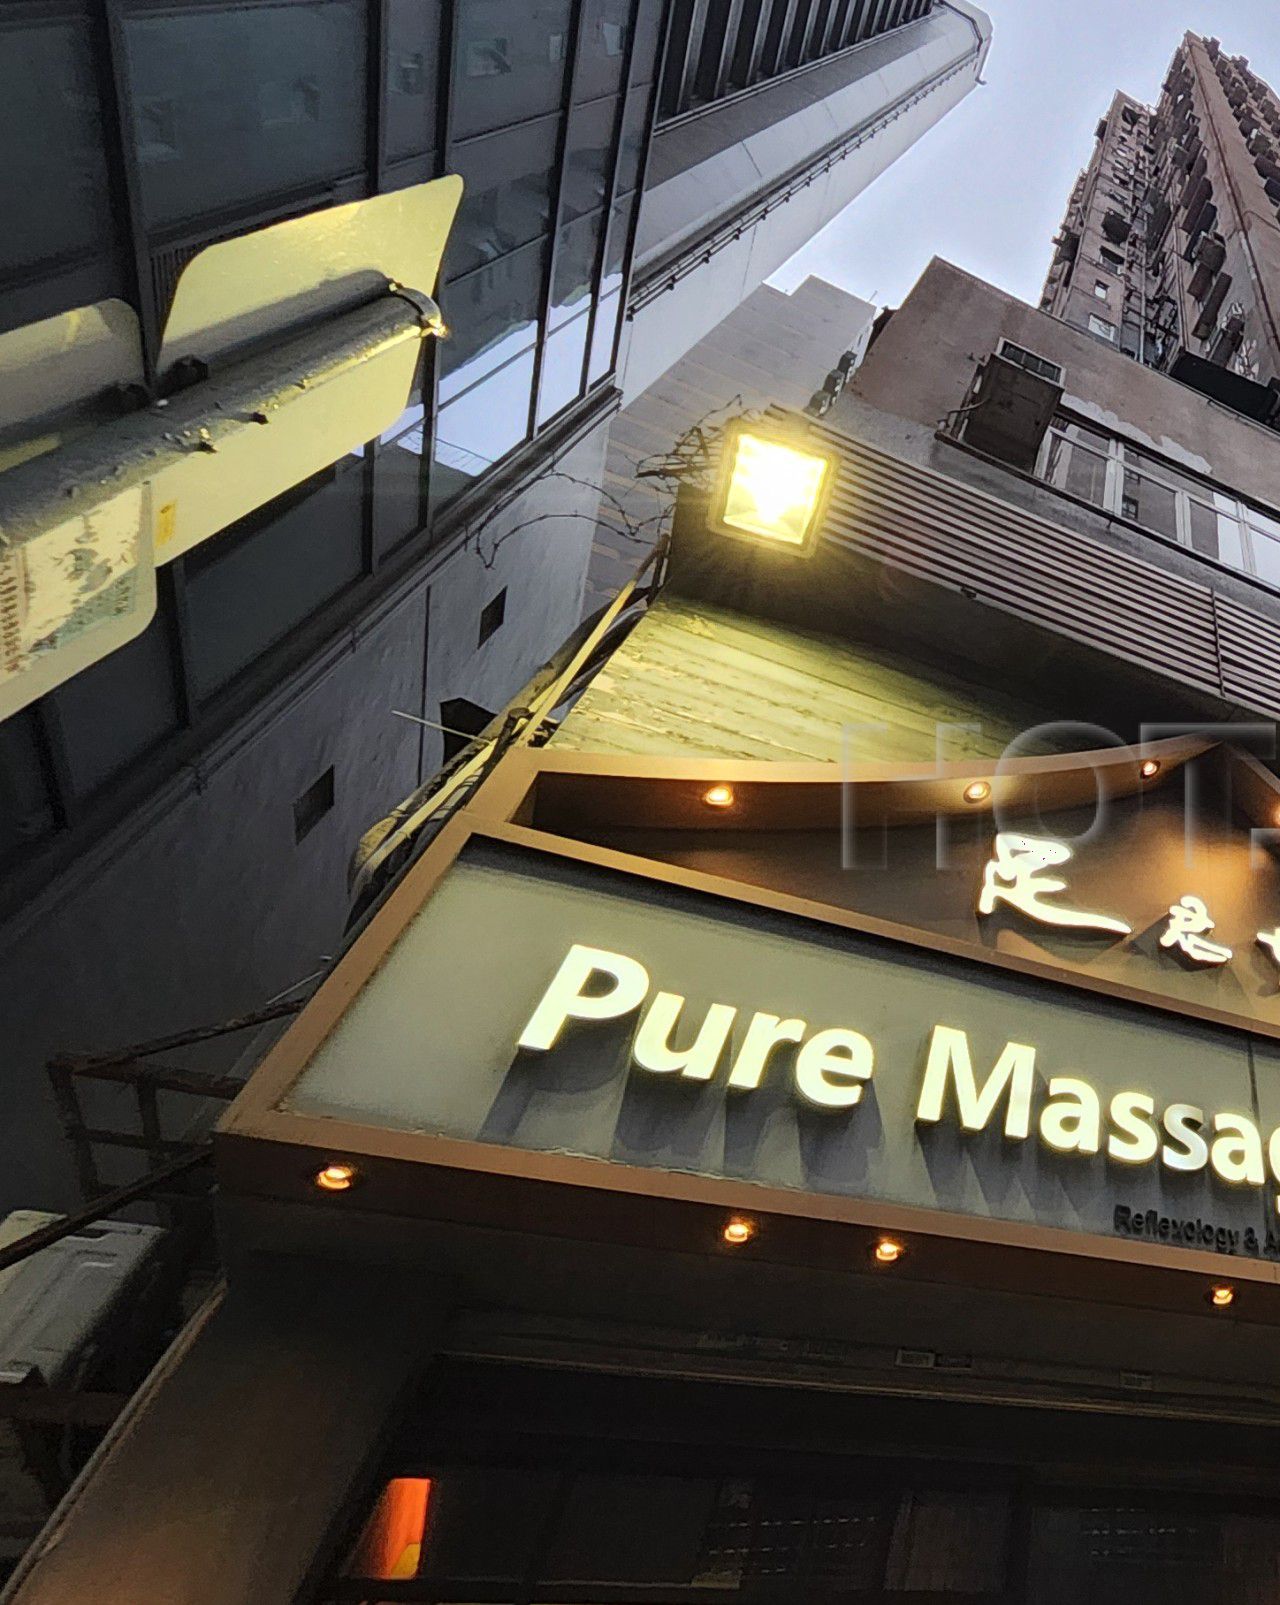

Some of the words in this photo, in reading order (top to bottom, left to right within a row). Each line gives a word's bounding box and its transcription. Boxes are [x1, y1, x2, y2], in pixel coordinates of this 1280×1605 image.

[518, 944, 875, 1107] Pure
[1113, 1204, 1240, 1256] Reflexology
[1243, 1227, 1259, 1253] &
